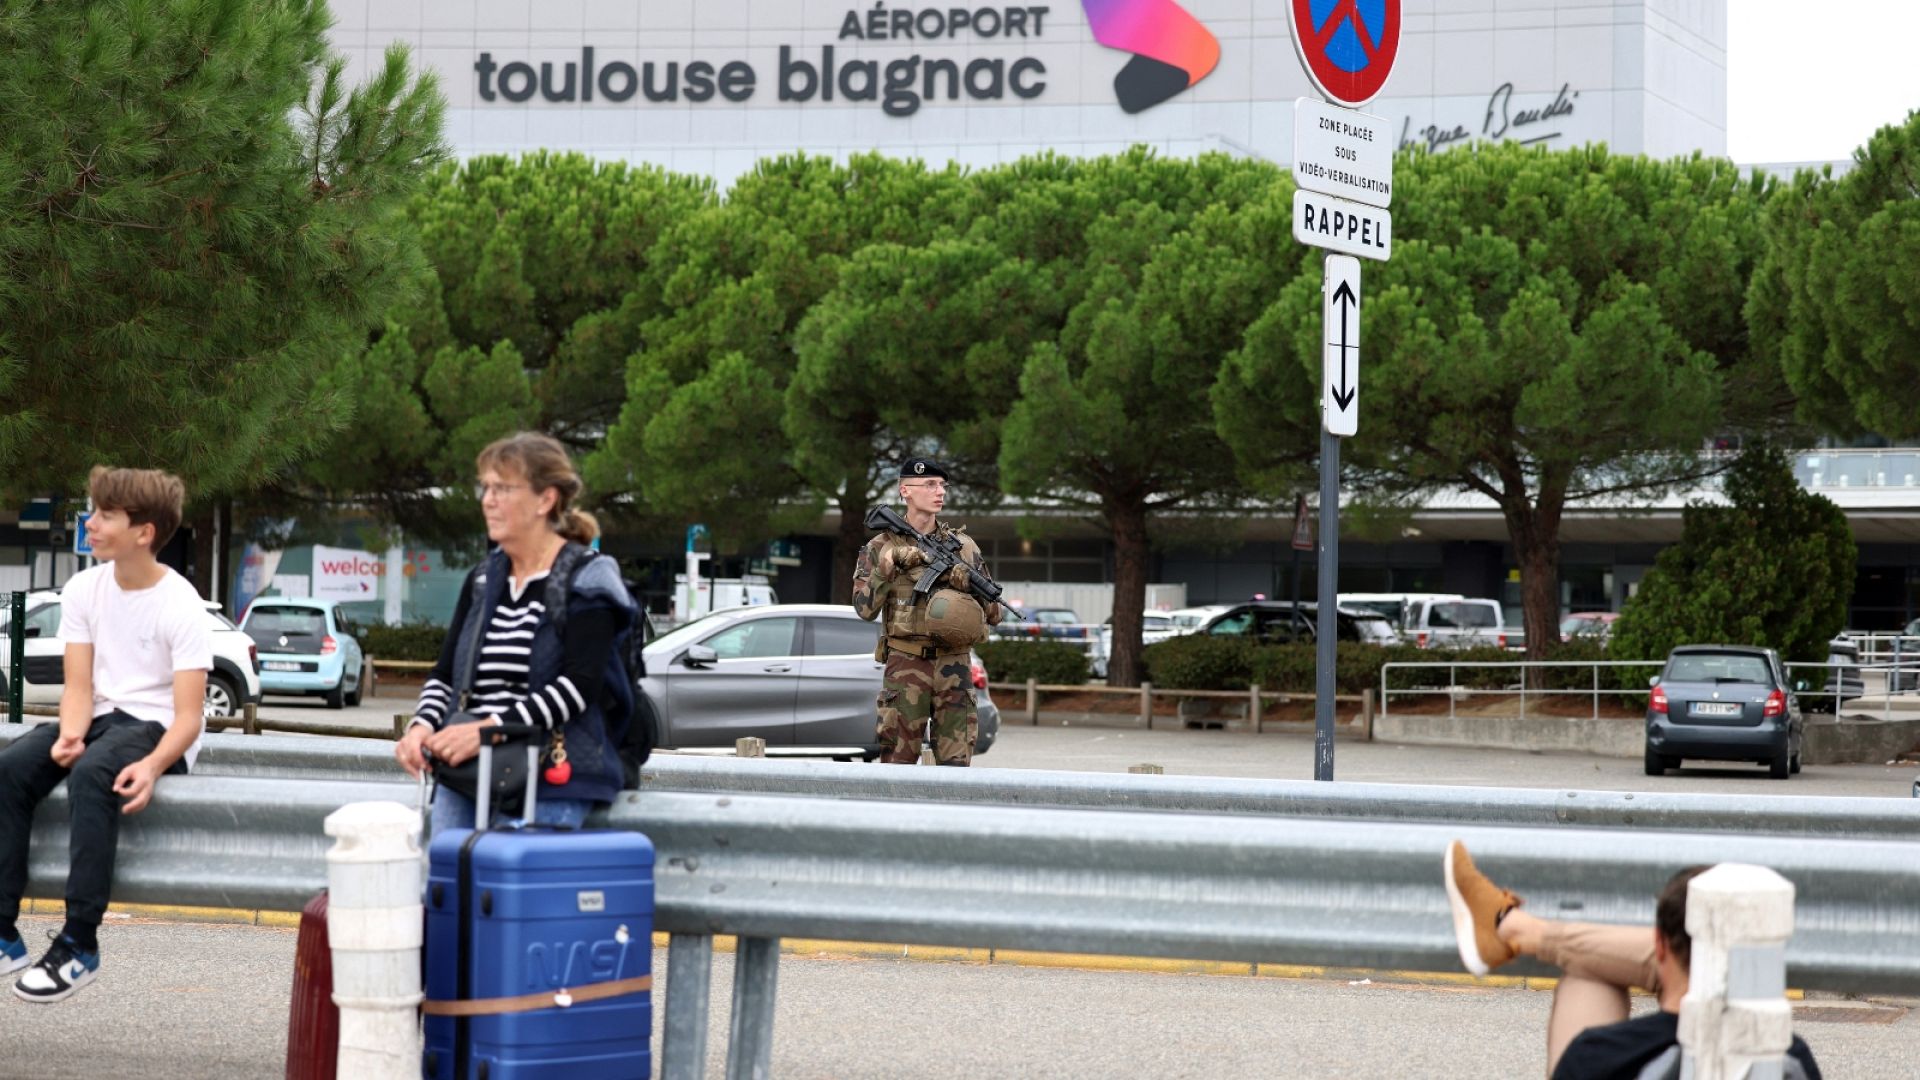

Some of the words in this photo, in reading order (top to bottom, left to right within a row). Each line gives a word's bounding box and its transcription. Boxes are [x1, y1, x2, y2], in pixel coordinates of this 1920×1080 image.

[838, 5, 1050, 40] AÉROPORT
[473, 45, 757, 103] toulouse
[777, 45, 1049, 118] blagnac
[1319, 116, 1341, 134] ZONE
[1343, 123, 1373, 143] PLACÉE
[1334, 145, 1358, 162] SOUS
[1299, 161, 1390, 195] VIDÉO-VERBALISATION
[1304, 203, 1385, 249] RAPPEL
